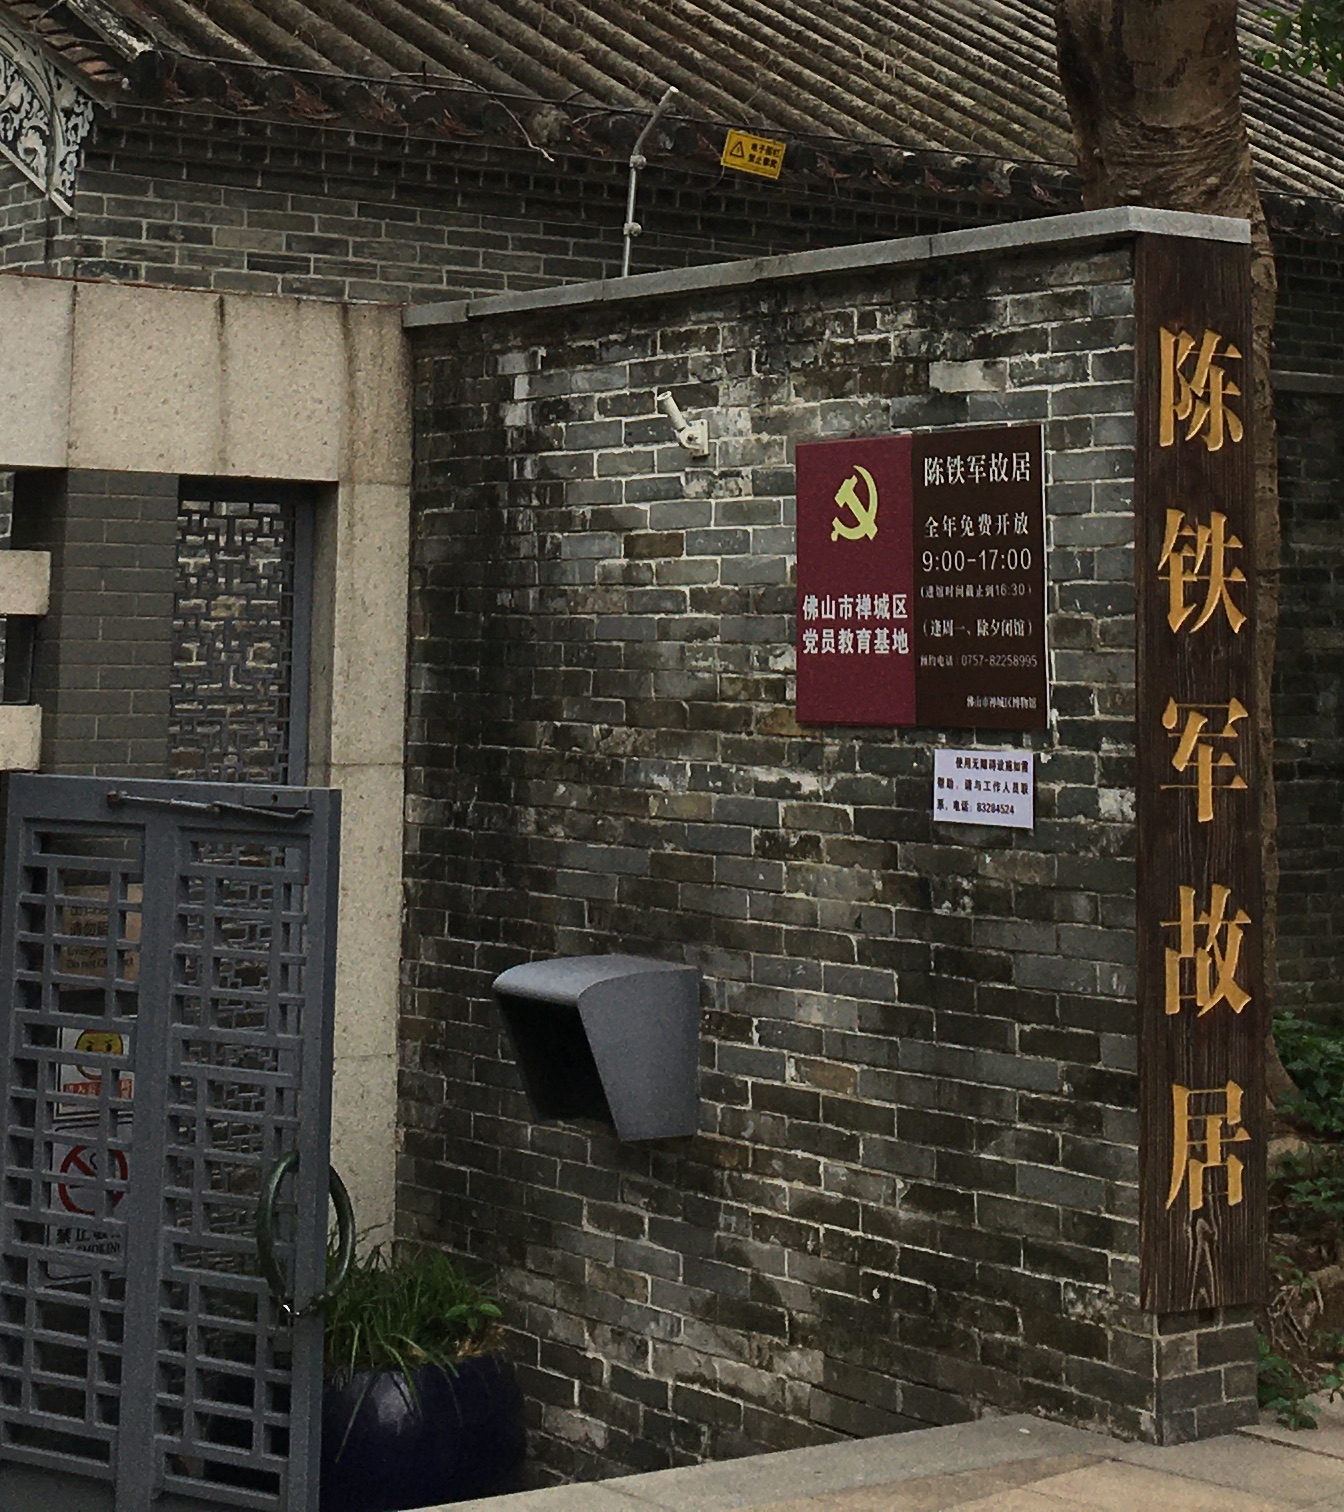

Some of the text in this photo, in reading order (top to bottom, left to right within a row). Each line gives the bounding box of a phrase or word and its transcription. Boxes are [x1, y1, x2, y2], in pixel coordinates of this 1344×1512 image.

[923, 451, 1031, 487] 陈铁军故居
[924, 511, 1029, 538] 全年免费开放
[922, 548, 1032, 572] 9:00-17:00
[802, 593, 909, 621] 佛山市禅城区
[802, 627, 910, 654] 党员教育基地
[1157, 325, 1253, 1212] 陈铁军故居
